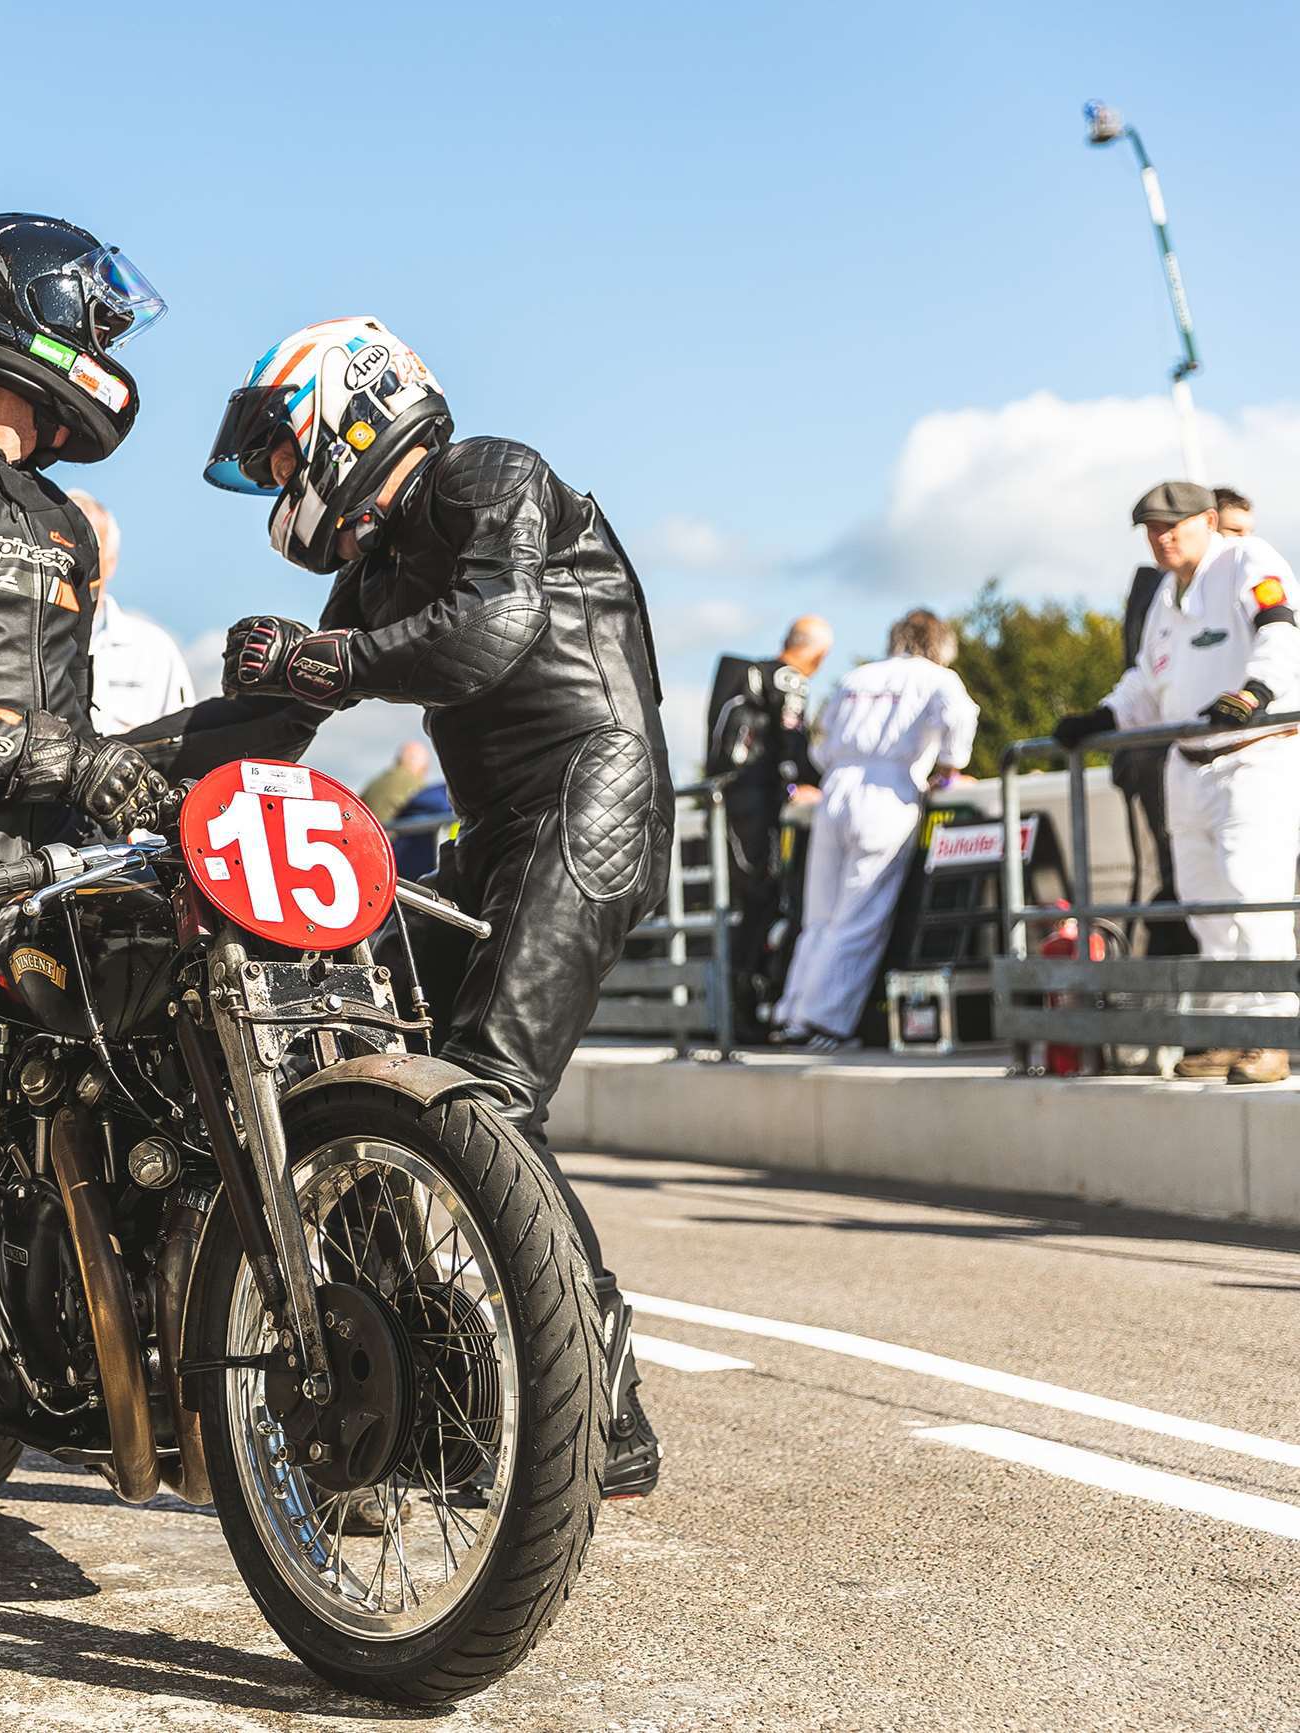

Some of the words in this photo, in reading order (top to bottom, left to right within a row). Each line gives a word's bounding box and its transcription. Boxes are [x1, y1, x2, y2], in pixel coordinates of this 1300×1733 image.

[352, 346, 385, 389] Arai
[293, 657, 339, 676] RST
[206, 791, 360, 929] 15
[15, 954, 54, 975] VINCENT
